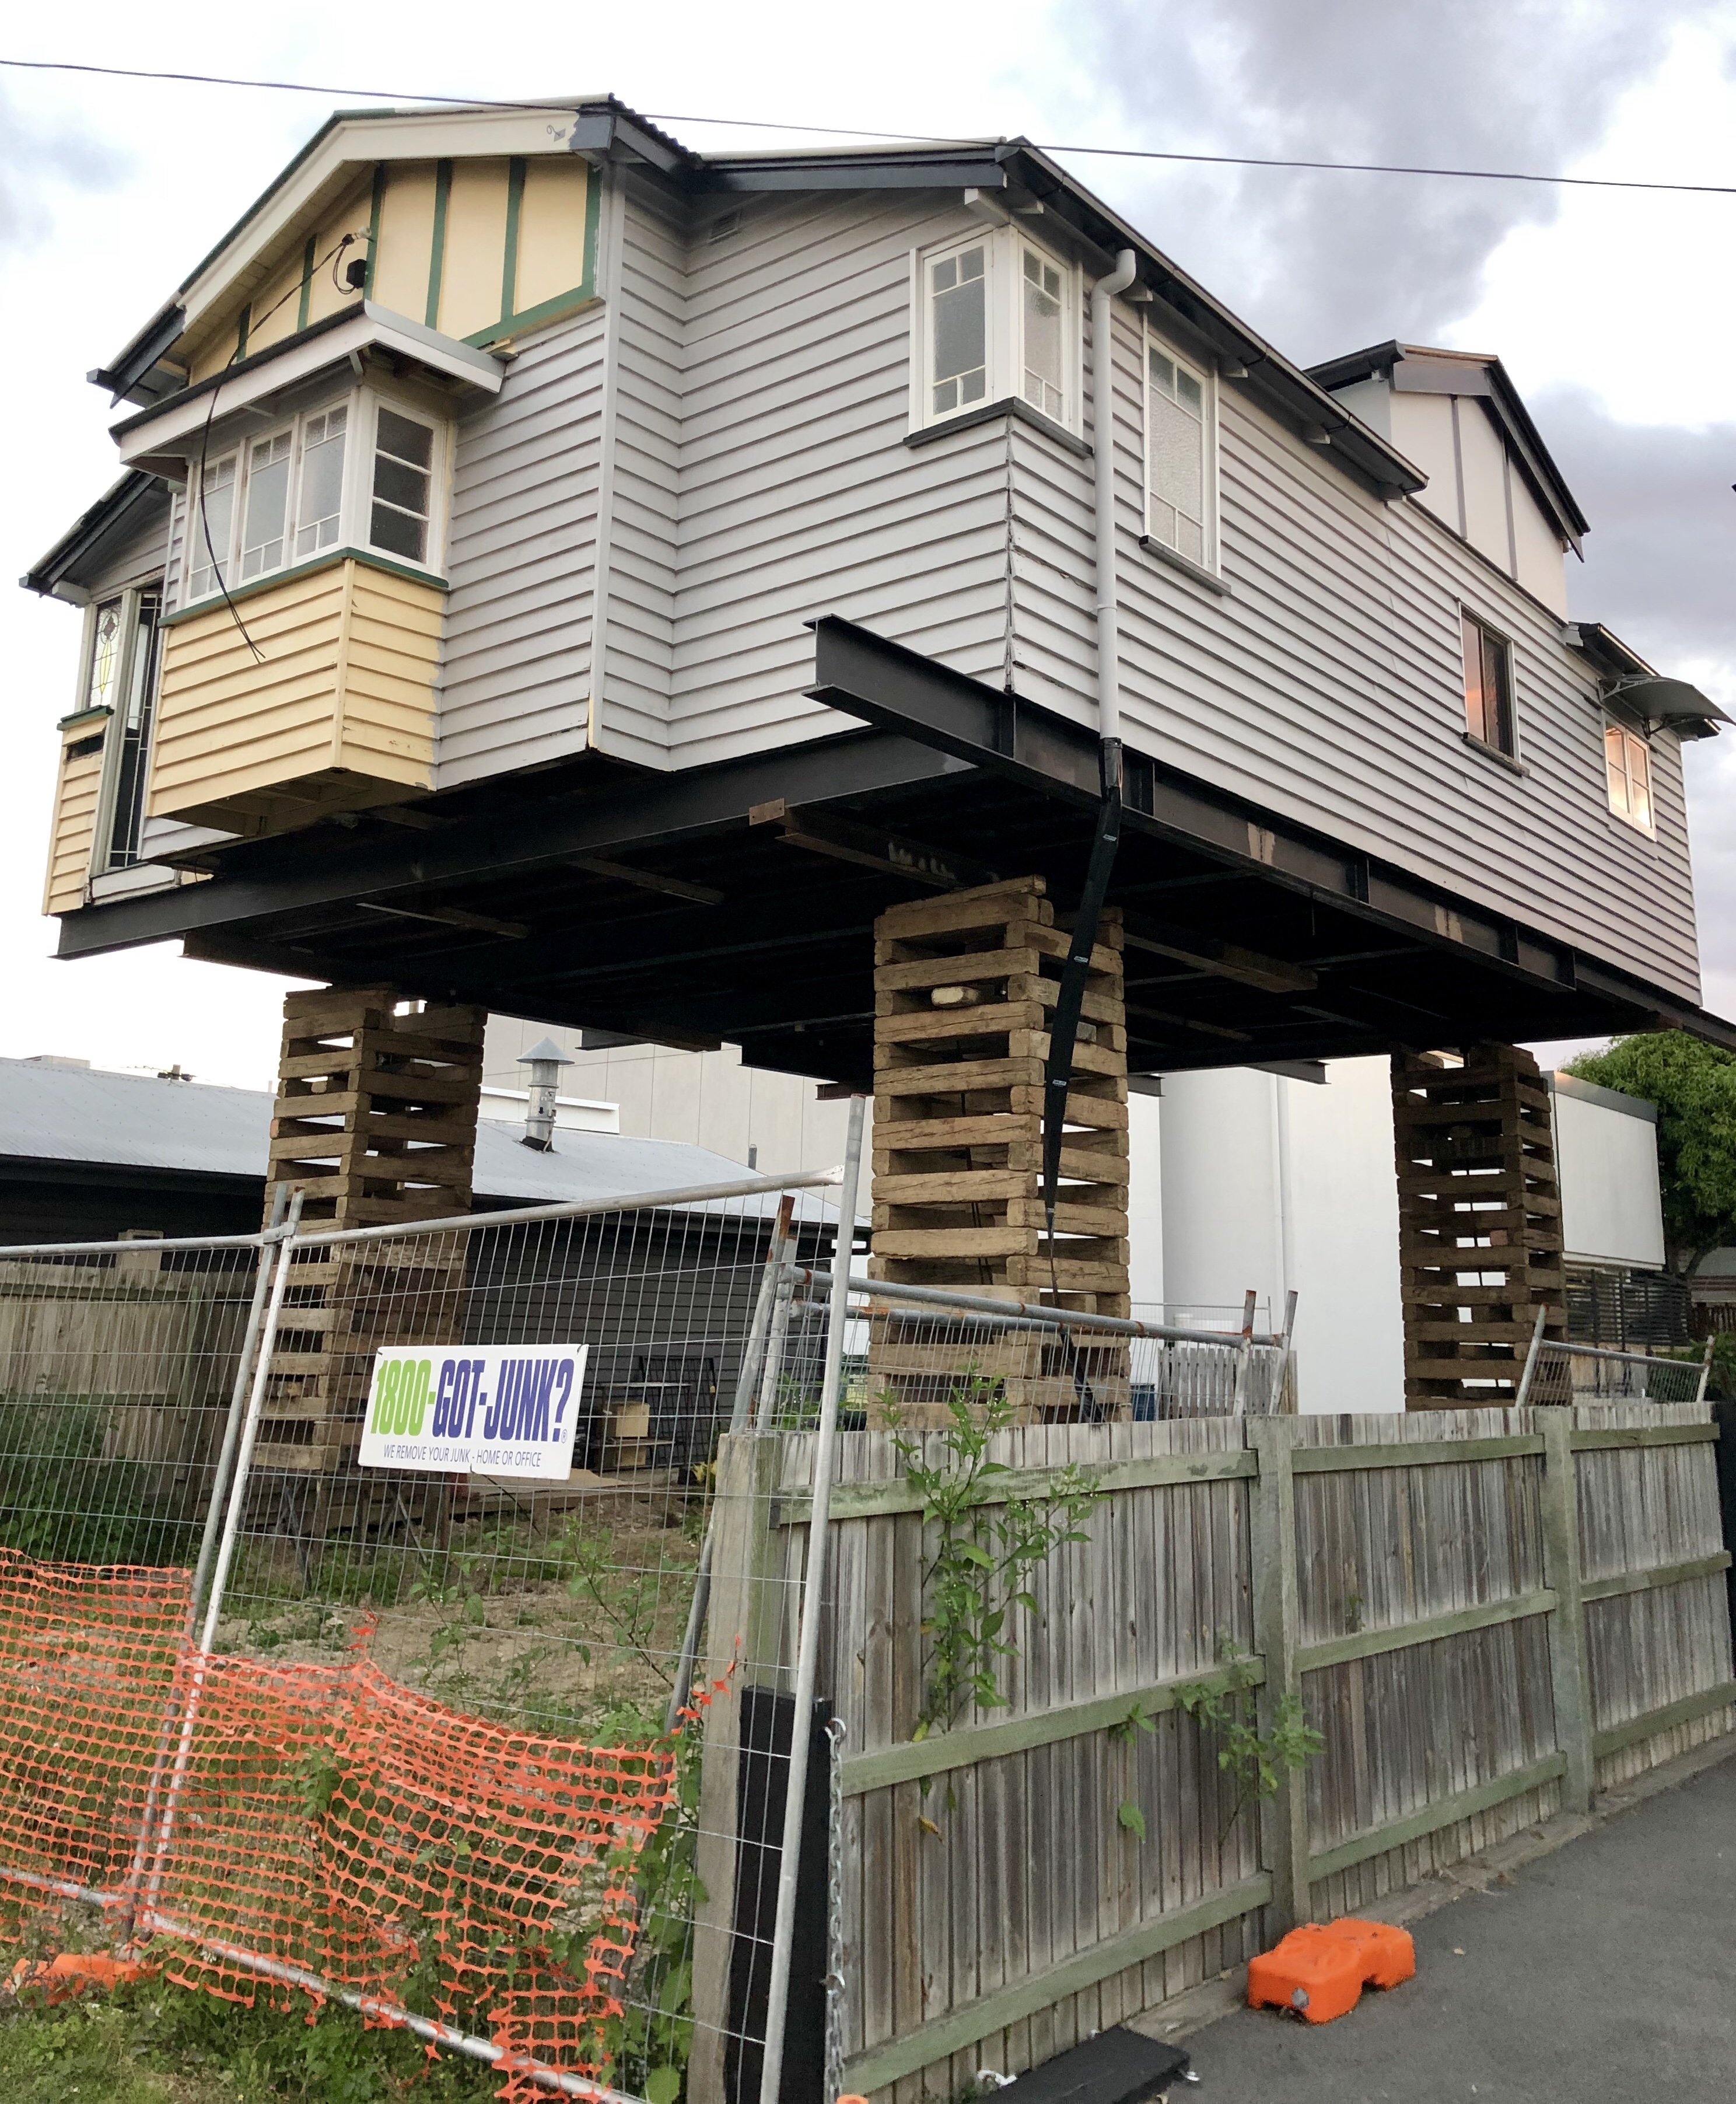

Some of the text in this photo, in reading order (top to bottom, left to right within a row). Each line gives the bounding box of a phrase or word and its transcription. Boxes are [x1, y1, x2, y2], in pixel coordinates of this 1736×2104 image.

[384, 1444, 396, 1458] WE
[396, 1445, 427, 1460] REMOVE
[429, 1446, 449, 1462] YOUR
[450, 1448, 471, 1463] JUNK
[476, 1449, 501, 1465] HOME
[502, 1451, 513, 1465] OR
[514, 1451, 542, 1467] OFFICE
